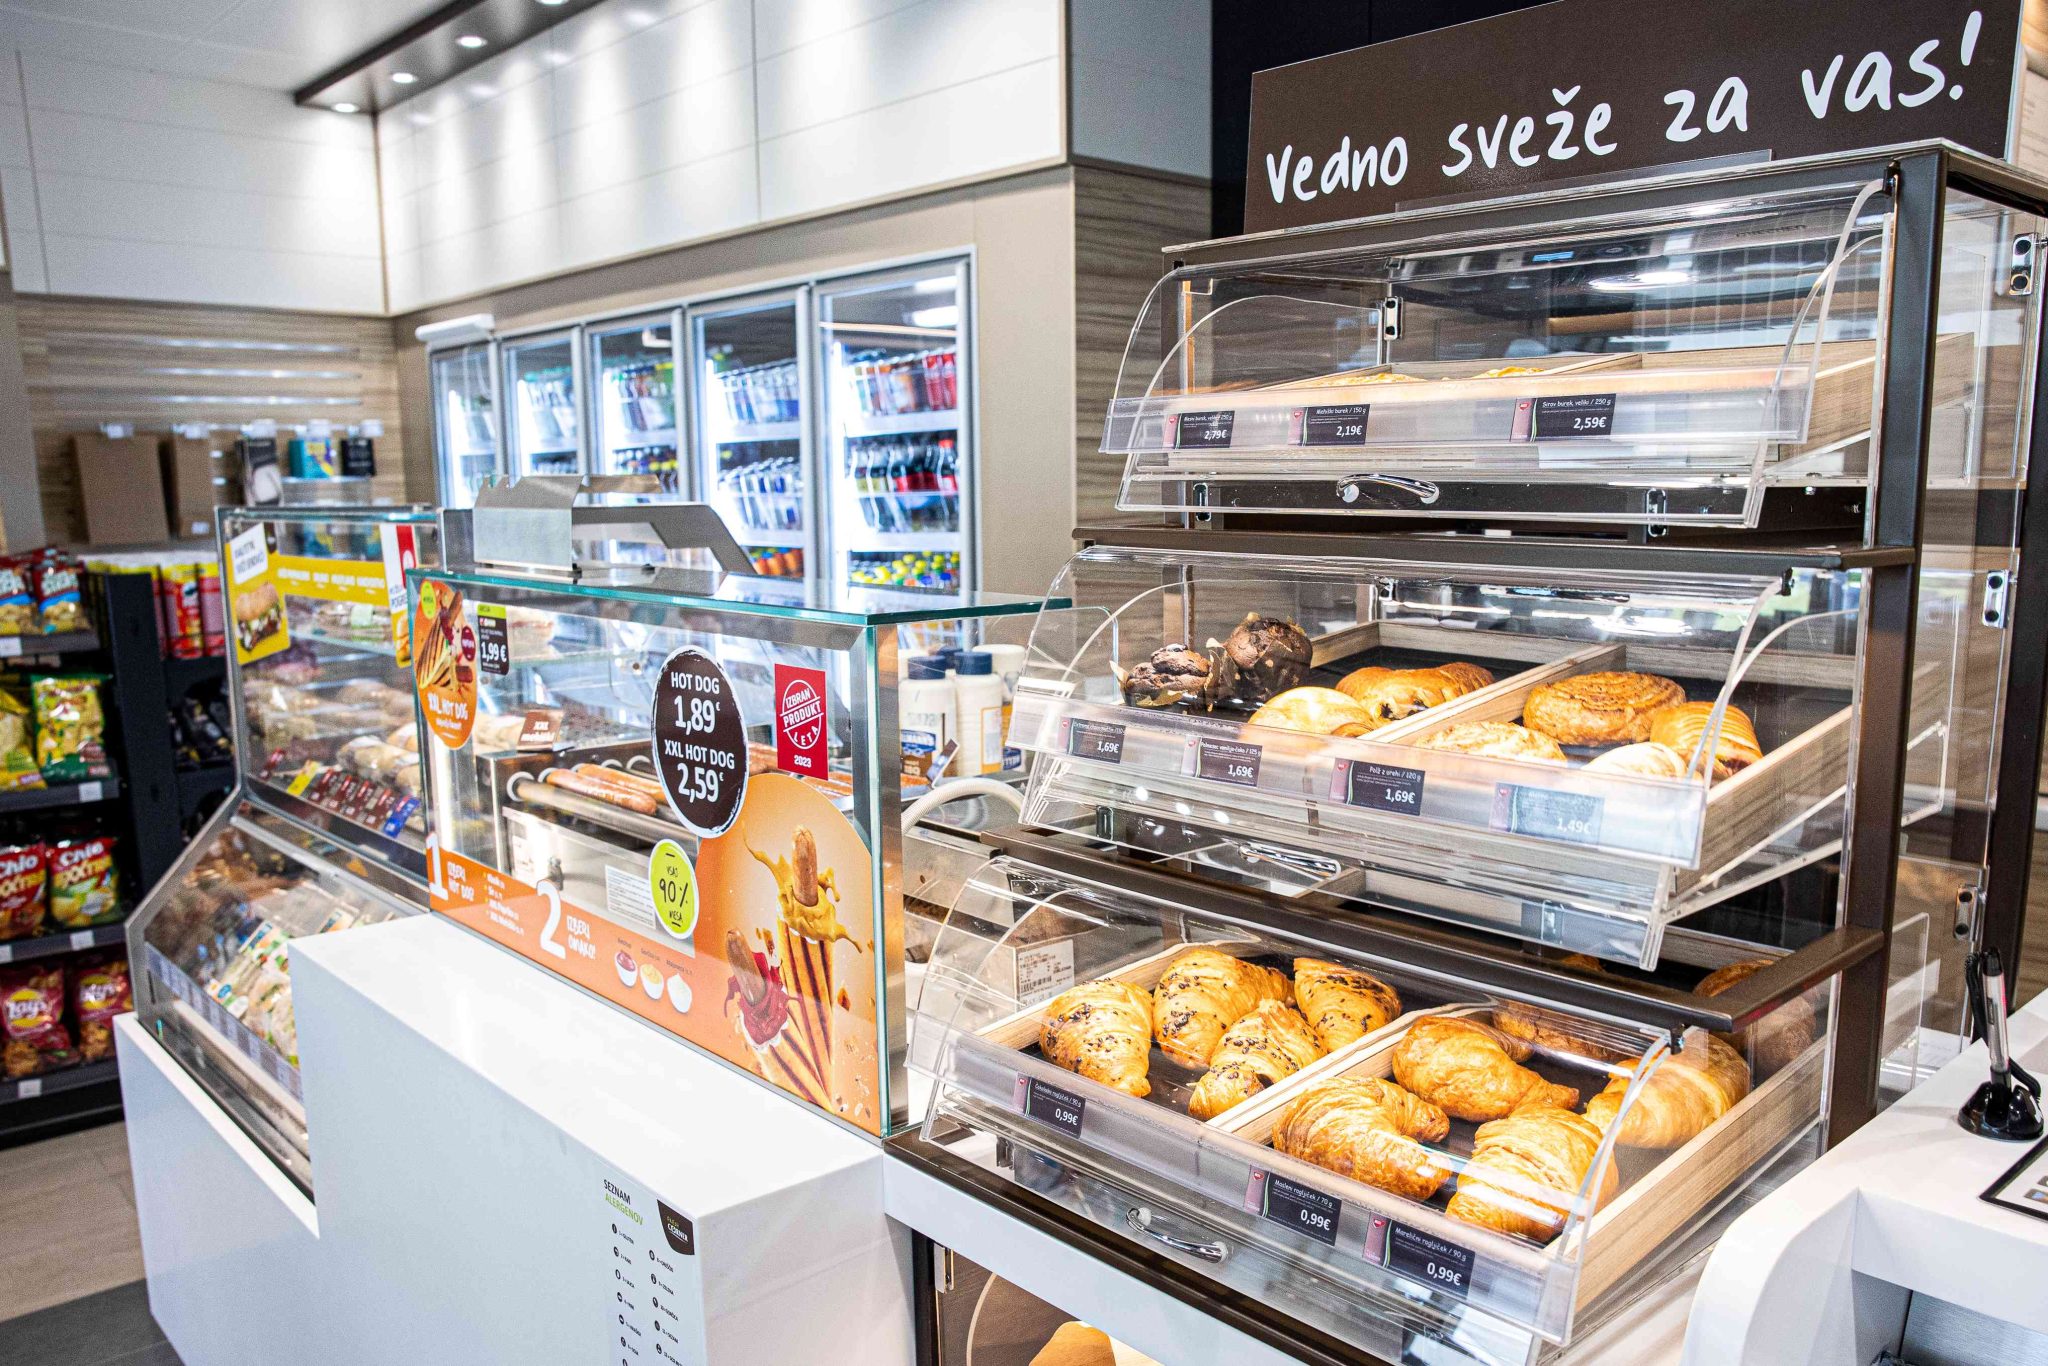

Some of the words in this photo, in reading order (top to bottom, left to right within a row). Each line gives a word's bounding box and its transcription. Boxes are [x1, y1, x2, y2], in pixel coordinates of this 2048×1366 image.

[1266, 135, 1407, 203] Vedno
[1442, 85, 1618, 178] sveže
[1664, 76, 1748, 142] za
[1801, 10, 1983, 119] vas!
[1336, 425, 1363, 437] 2,19€
[1573, 417, 1607, 430] 2,59€
[1204, 429, 1228, 441] 2,79€
[481, 641, 499, 662] 1,99
[671, 672, 693, 690] HOT
[695, 676, 720, 695] DOG
[785, 688, 811, 709] IZBRAN
[783, 700, 822, 728] PRODUKT
[793, 725, 820, 746] LETA
[1097, 740, 1120, 753] 1,69€
[664, 739, 684, 757] XXL
[686, 744, 707, 763] HOT
[710, 750, 735, 770] DOG
[794, 755, 811, 768] 2023
[1228, 764, 1254, 778] 1,69€
[1385, 788, 1416, 804] 1,69€
[59, 841, 104, 867] Chio
[426, 832, 449, 901] 1
[536, 879, 567, 960] 2
[1055, 1108, 1078, 1126] 0,99€
[604, 1179, 631, 1205] SEZNAM
[1275, 1180, 1292, 1192] Masleni
[1321, 1197, 1328, 1205] 70
[605, 1193, 643, 1226] ALERGENOV
[1300, 1209, 1331, 1231] 0,99€
[667, 1223, 688, 1243] CORNER
[1395, 1227, 1420, 1242] Marelični
[1422, 1239, 1447, 1252] rogljiček
[1453, 1249, 1462, 1258] 90
[1427, 1262, 1462, 1286] 0,99€
